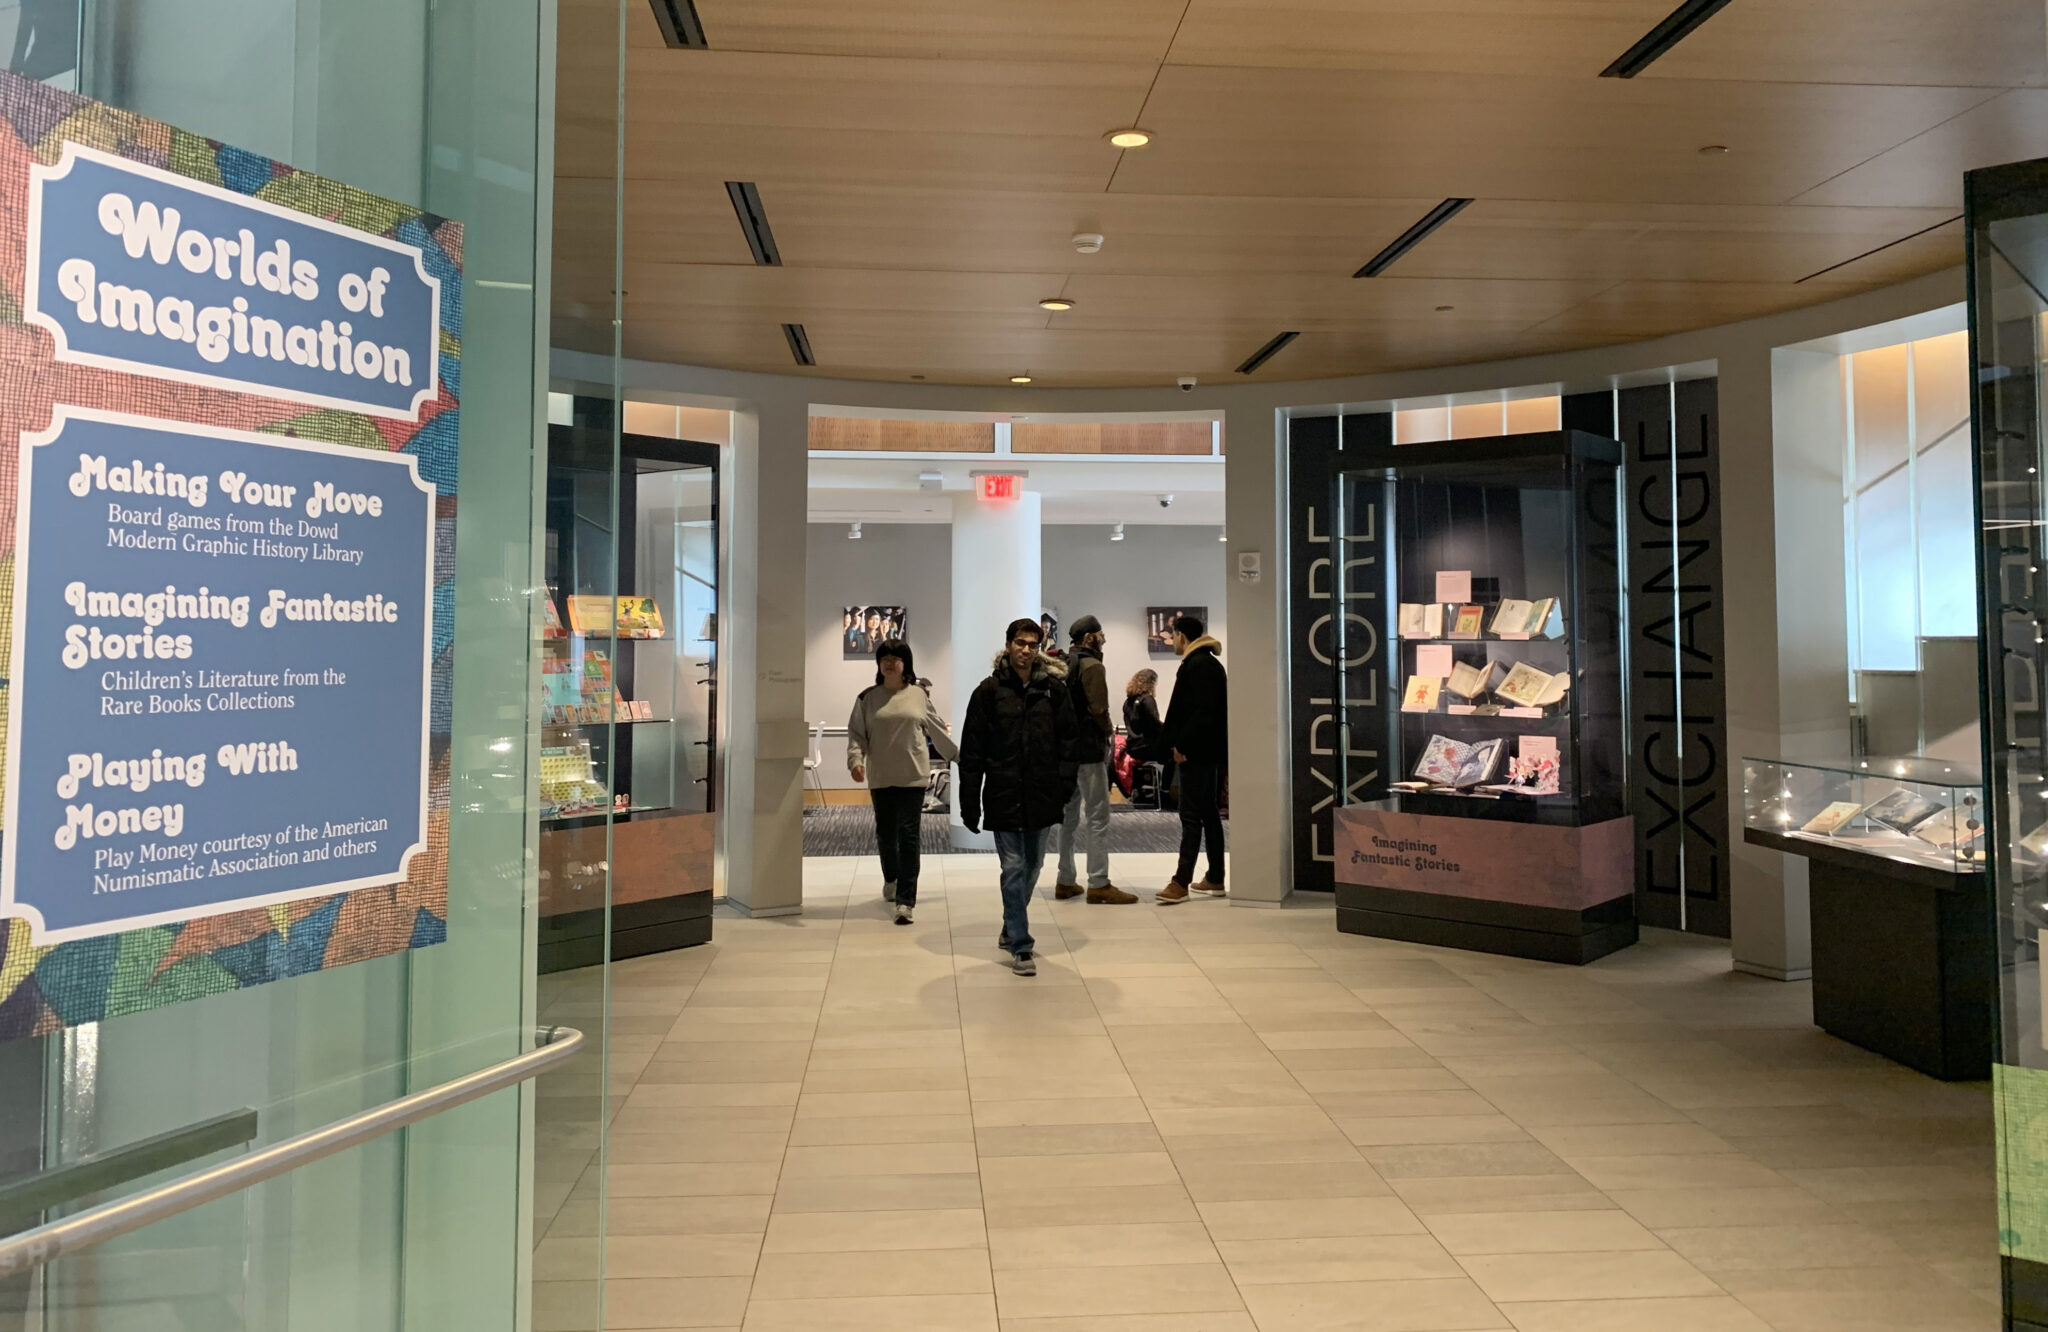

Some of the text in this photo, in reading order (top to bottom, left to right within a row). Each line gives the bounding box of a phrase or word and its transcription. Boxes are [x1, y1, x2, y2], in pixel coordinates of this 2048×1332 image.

[98, 193, 391, 318] Worlds of
[57, 258, 412, 386] Imagination
[69, 453, 383, 518] Making Your Move
[984, 475, 1013, 497] EXIT
[107, 504, 339, 540] Board games from the Dowd
[107, 528, 364, 565] Modern Graphic History Library
[64, 581, 398, 628] Imagining Fantastic
[61, 624, 193, 669] Stories
[1638, 413, 1719, 901] EXCHANGE
[101, 668, 346, 691] Children's Literature from the
[101, 692, 295, 716] Rare Books Collections
[56, 740, 298, 799] Playing With
[54, 803, 184, 850] Money
[94, 816, 388, 870] Play Money courtesy of the American
[1372, 836, 1437, 856] Imagining
[93, 840, 377, 894] Numismatic Association and others
[1351, 850, 1461, 872] Fantastic Stories
